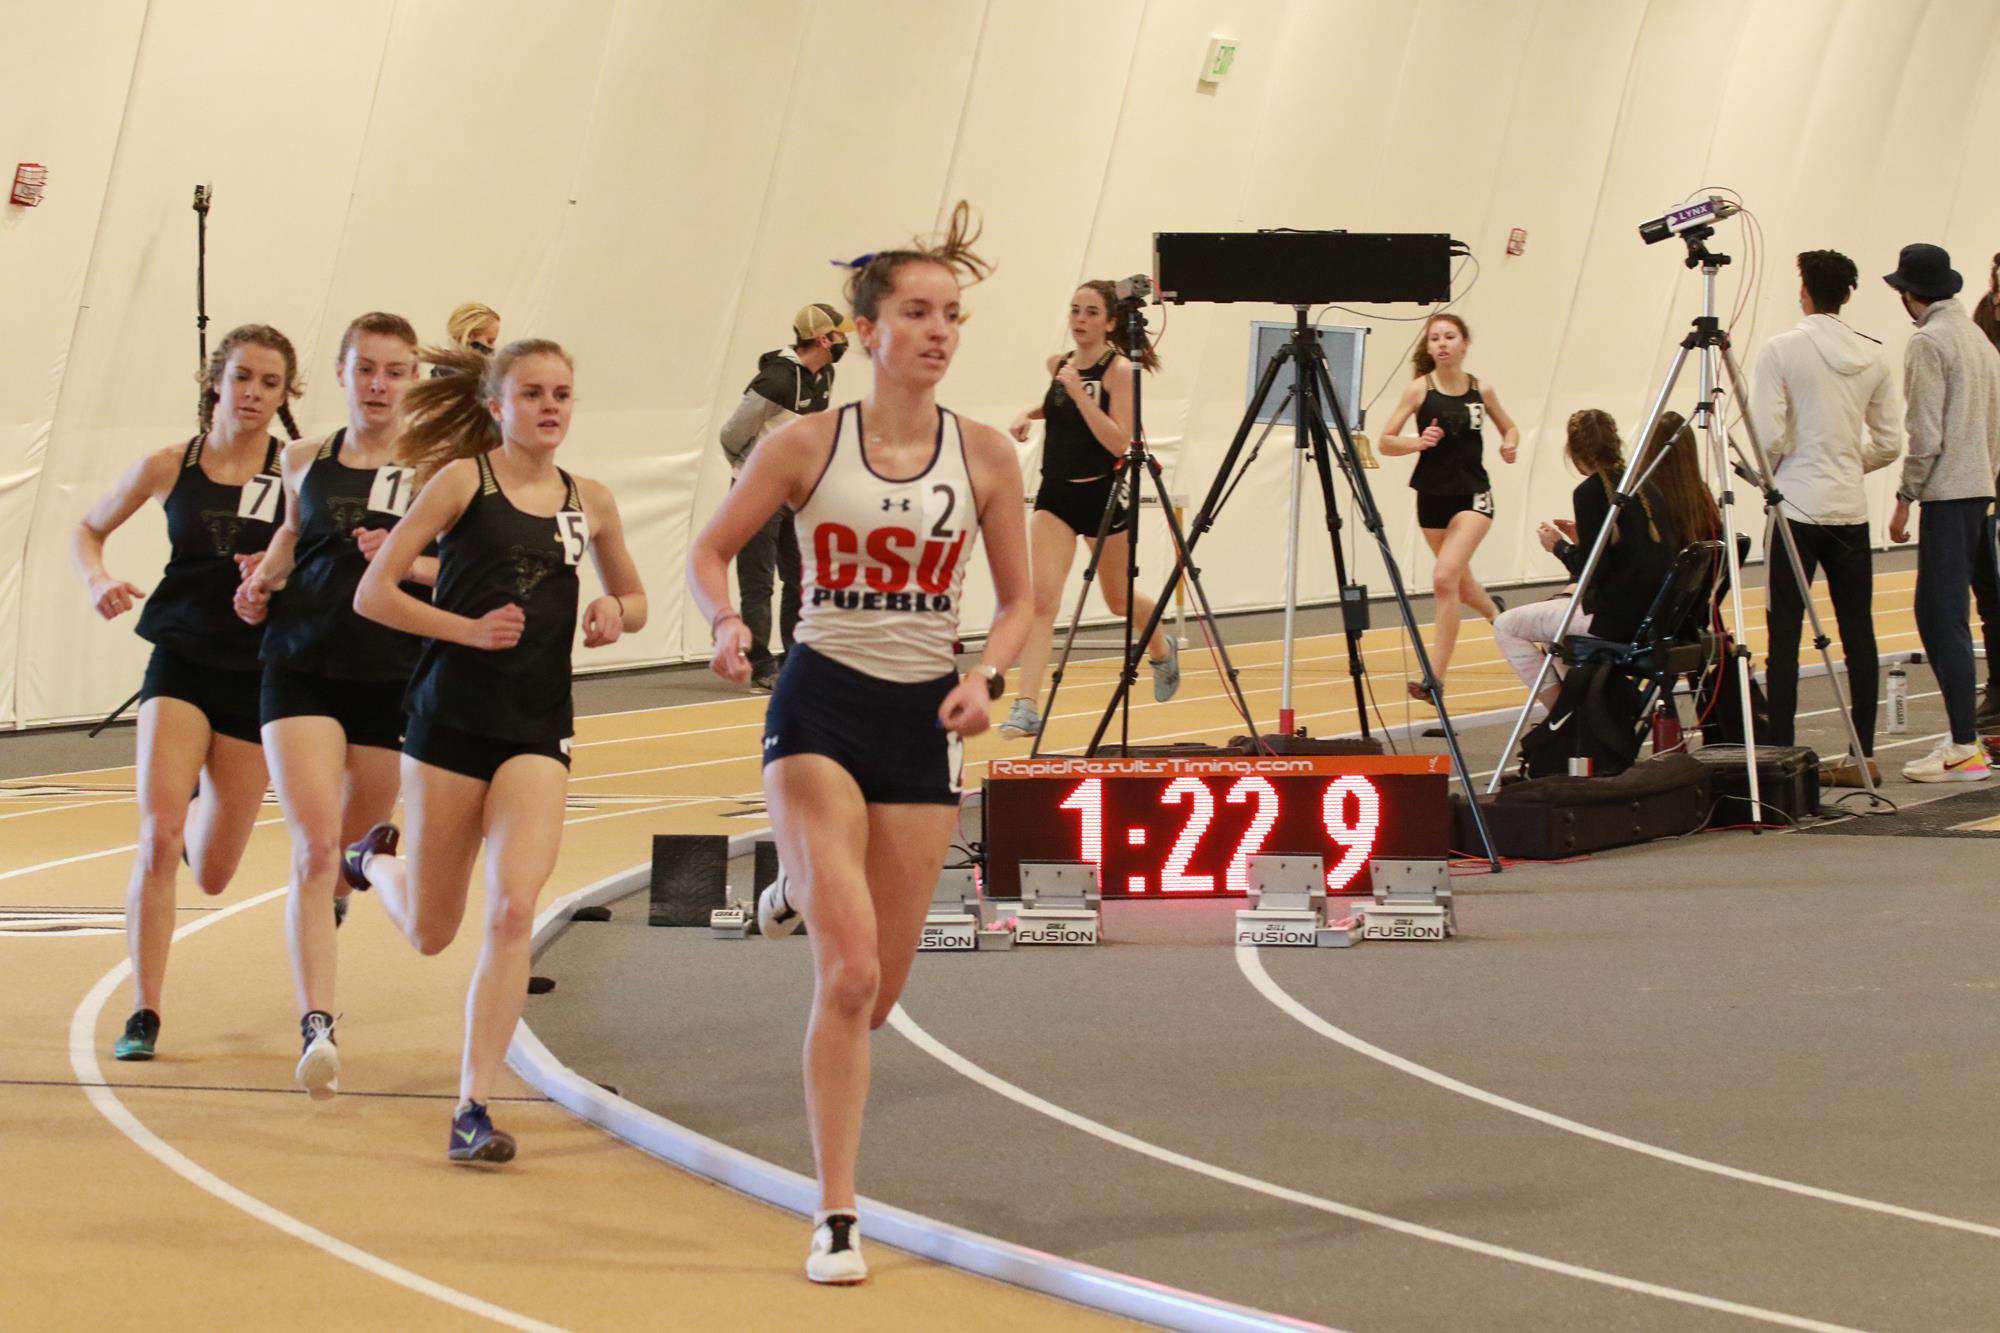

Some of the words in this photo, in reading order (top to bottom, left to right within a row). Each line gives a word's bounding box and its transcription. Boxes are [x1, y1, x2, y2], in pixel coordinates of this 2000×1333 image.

[1678, 203, 1709, 220] LYNX
[250, 476, 274, 516] 7
[385, 469, 403, 510] 1
[930, 483, 956, 538] 2
[565, 515, 586, 563] 5
[813, 522, 967, 594] CSU
[812, 588, 952, 612] PUEBLO
[992, 758, 1314, 776] RapidResultsTiming.com
[918, 936, 972, 947] SION
[1018, 930, 1093, 942] FUSION
[1238, 931, 1313, 943] FUSION
[1366, 926, 1441, 938] FUSION
